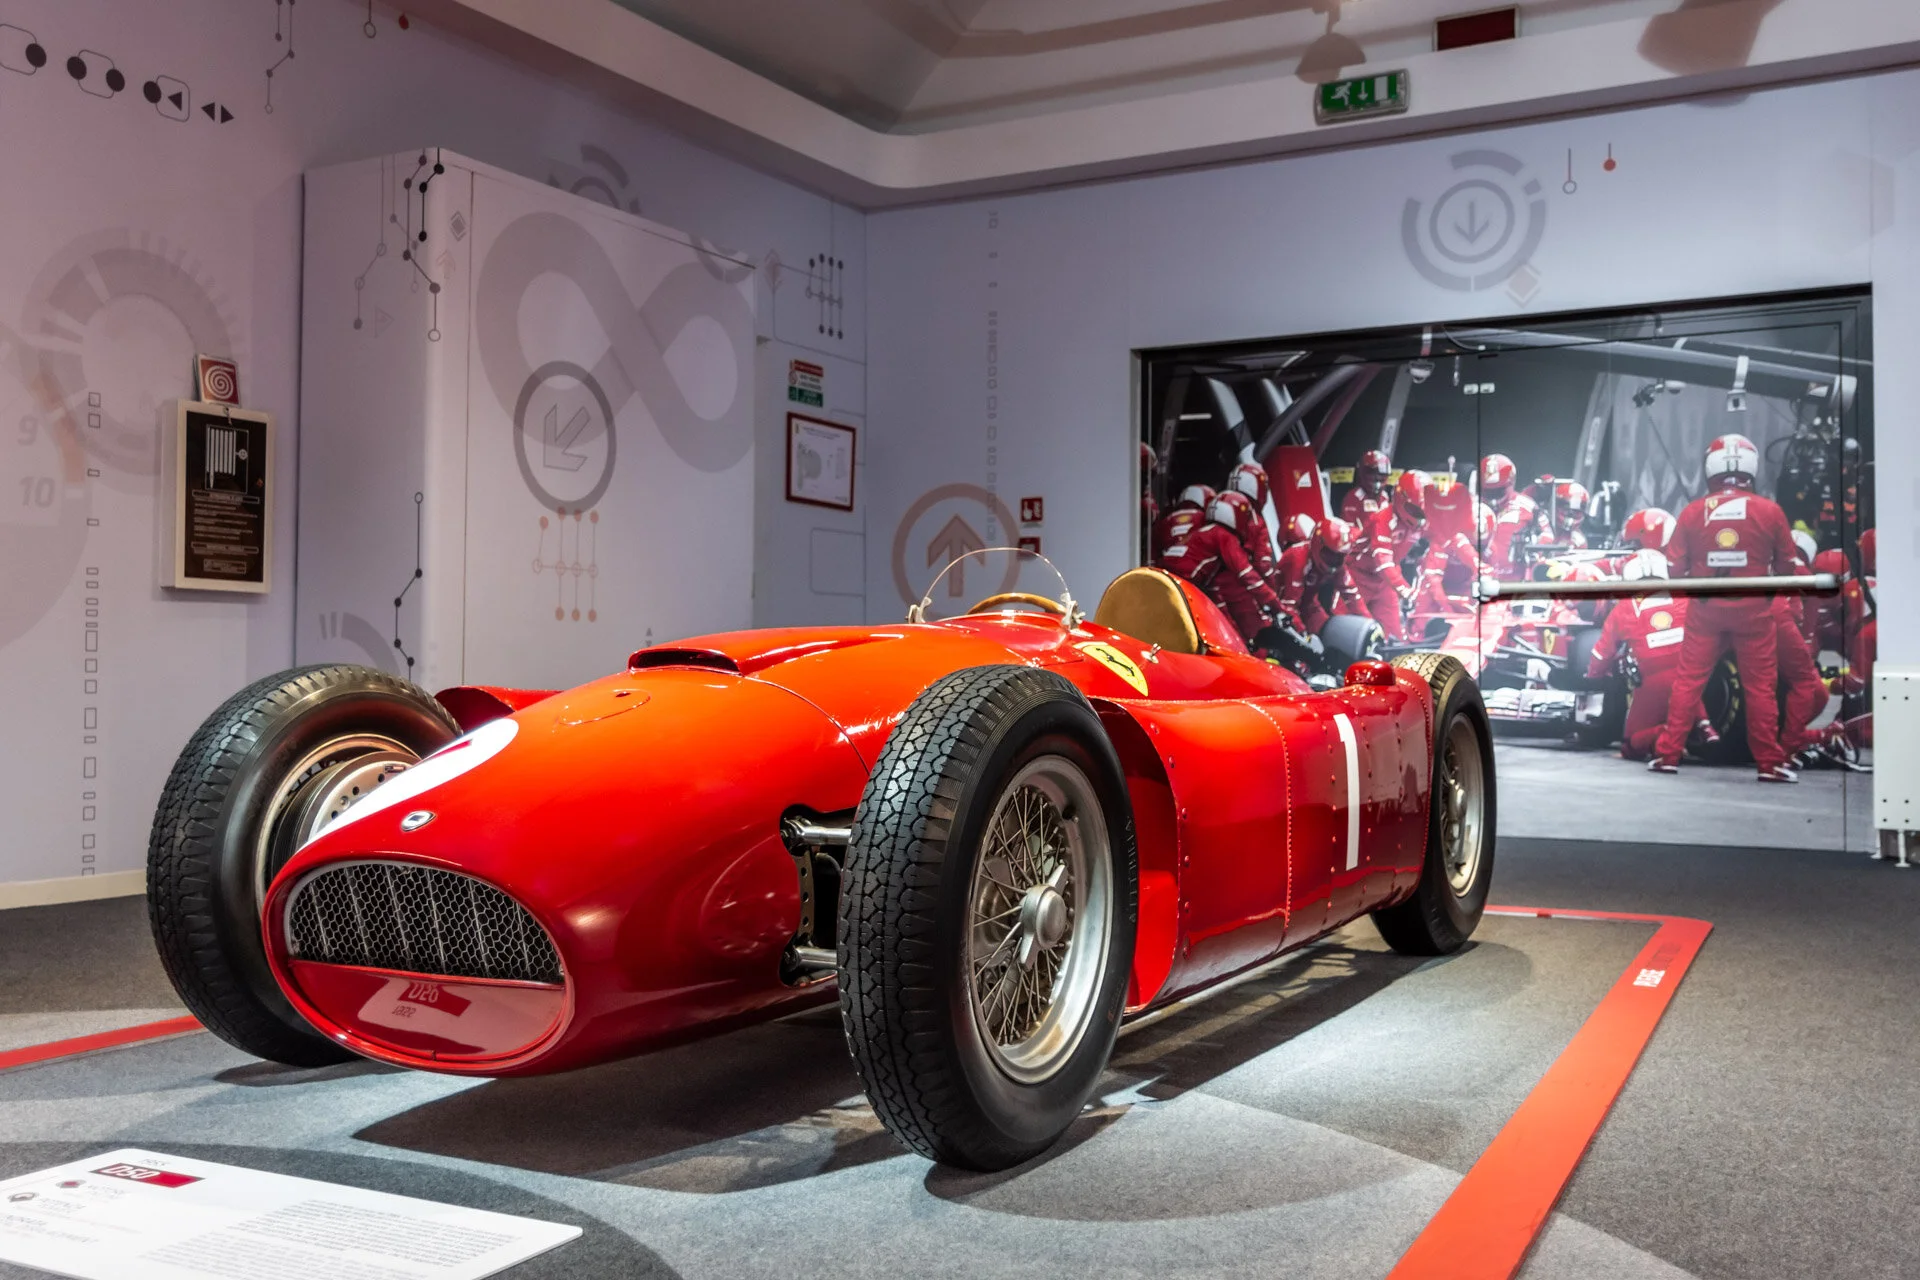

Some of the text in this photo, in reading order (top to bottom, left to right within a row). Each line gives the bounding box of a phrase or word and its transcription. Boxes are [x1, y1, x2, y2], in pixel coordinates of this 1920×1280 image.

[17, 414, 39, 447] 9
[18, 475, 56, 508] 10
[1333, 713, 1360, 871] 1
[100, 1165, 161, 1179] D50
